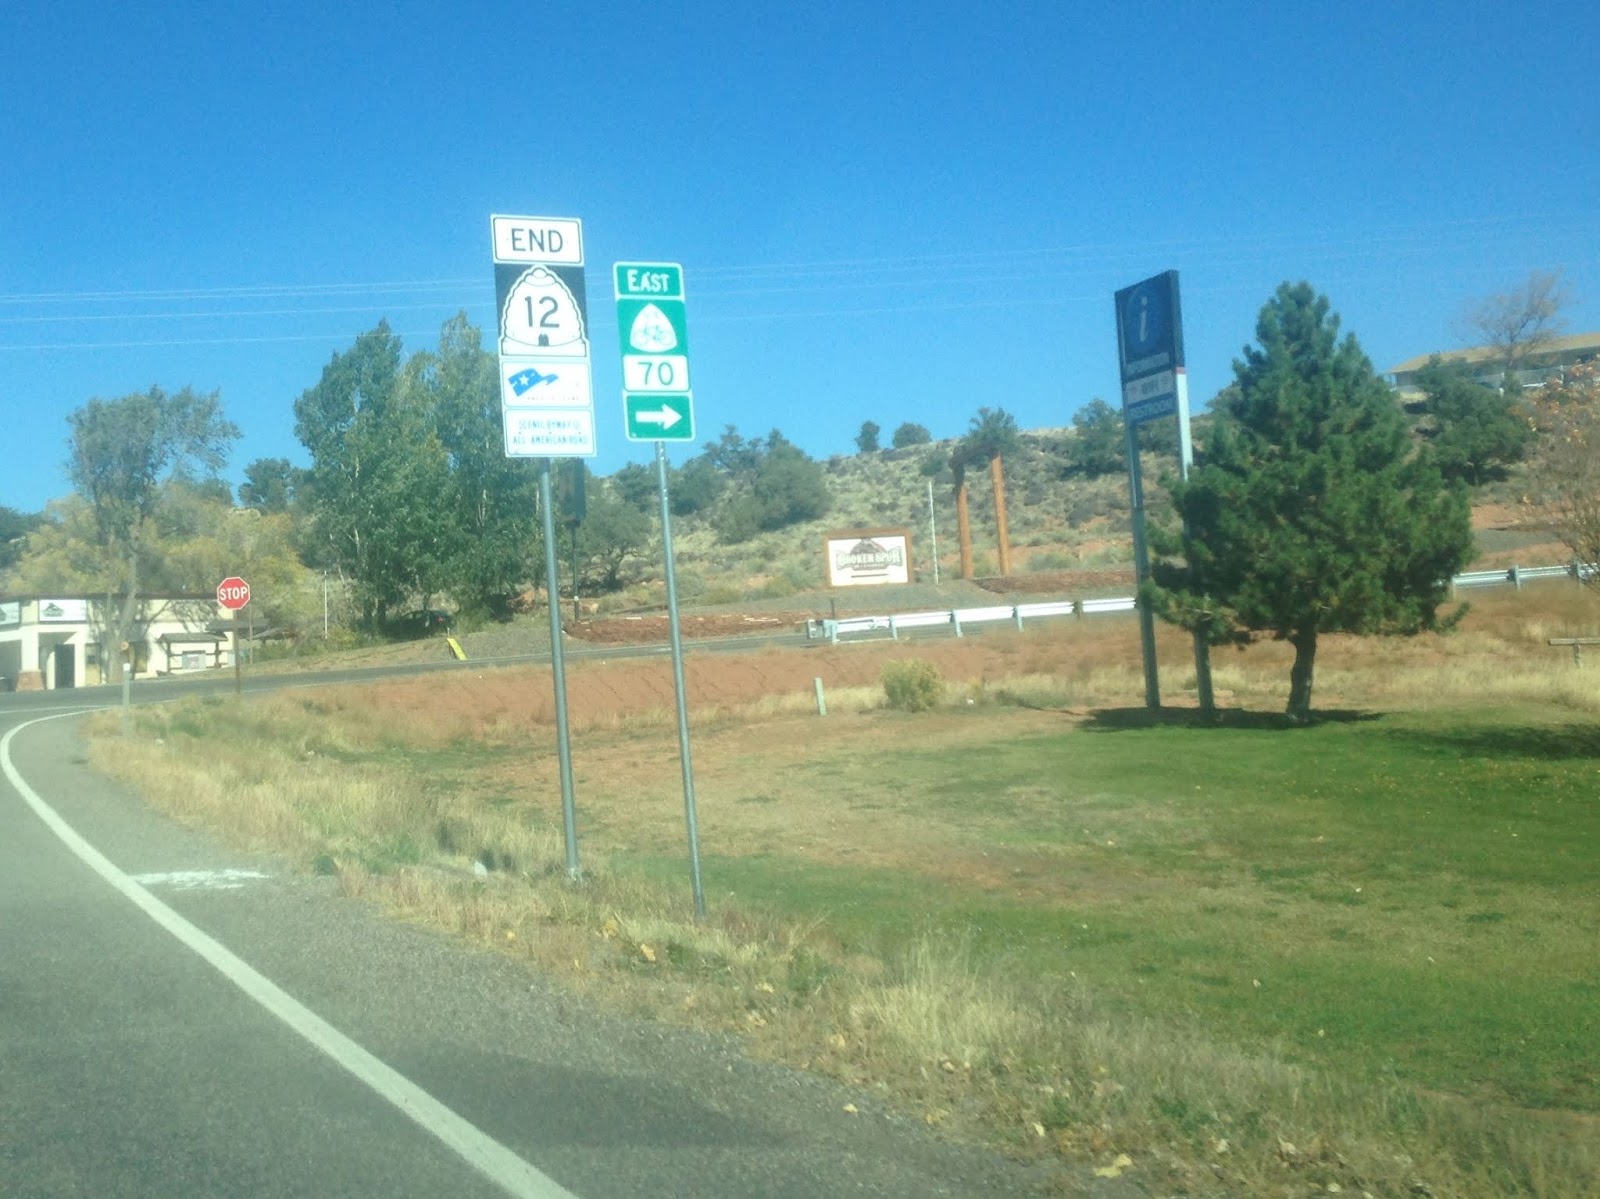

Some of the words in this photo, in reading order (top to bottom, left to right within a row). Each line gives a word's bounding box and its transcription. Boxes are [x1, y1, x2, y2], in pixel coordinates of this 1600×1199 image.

[511, 228, 563, 253] END
[627, 269, 669, 293] EAST
[524, 296, 560, 328] 12
[637, 362, 674, 386] 70
[219, 587, 248, 601] STOP
